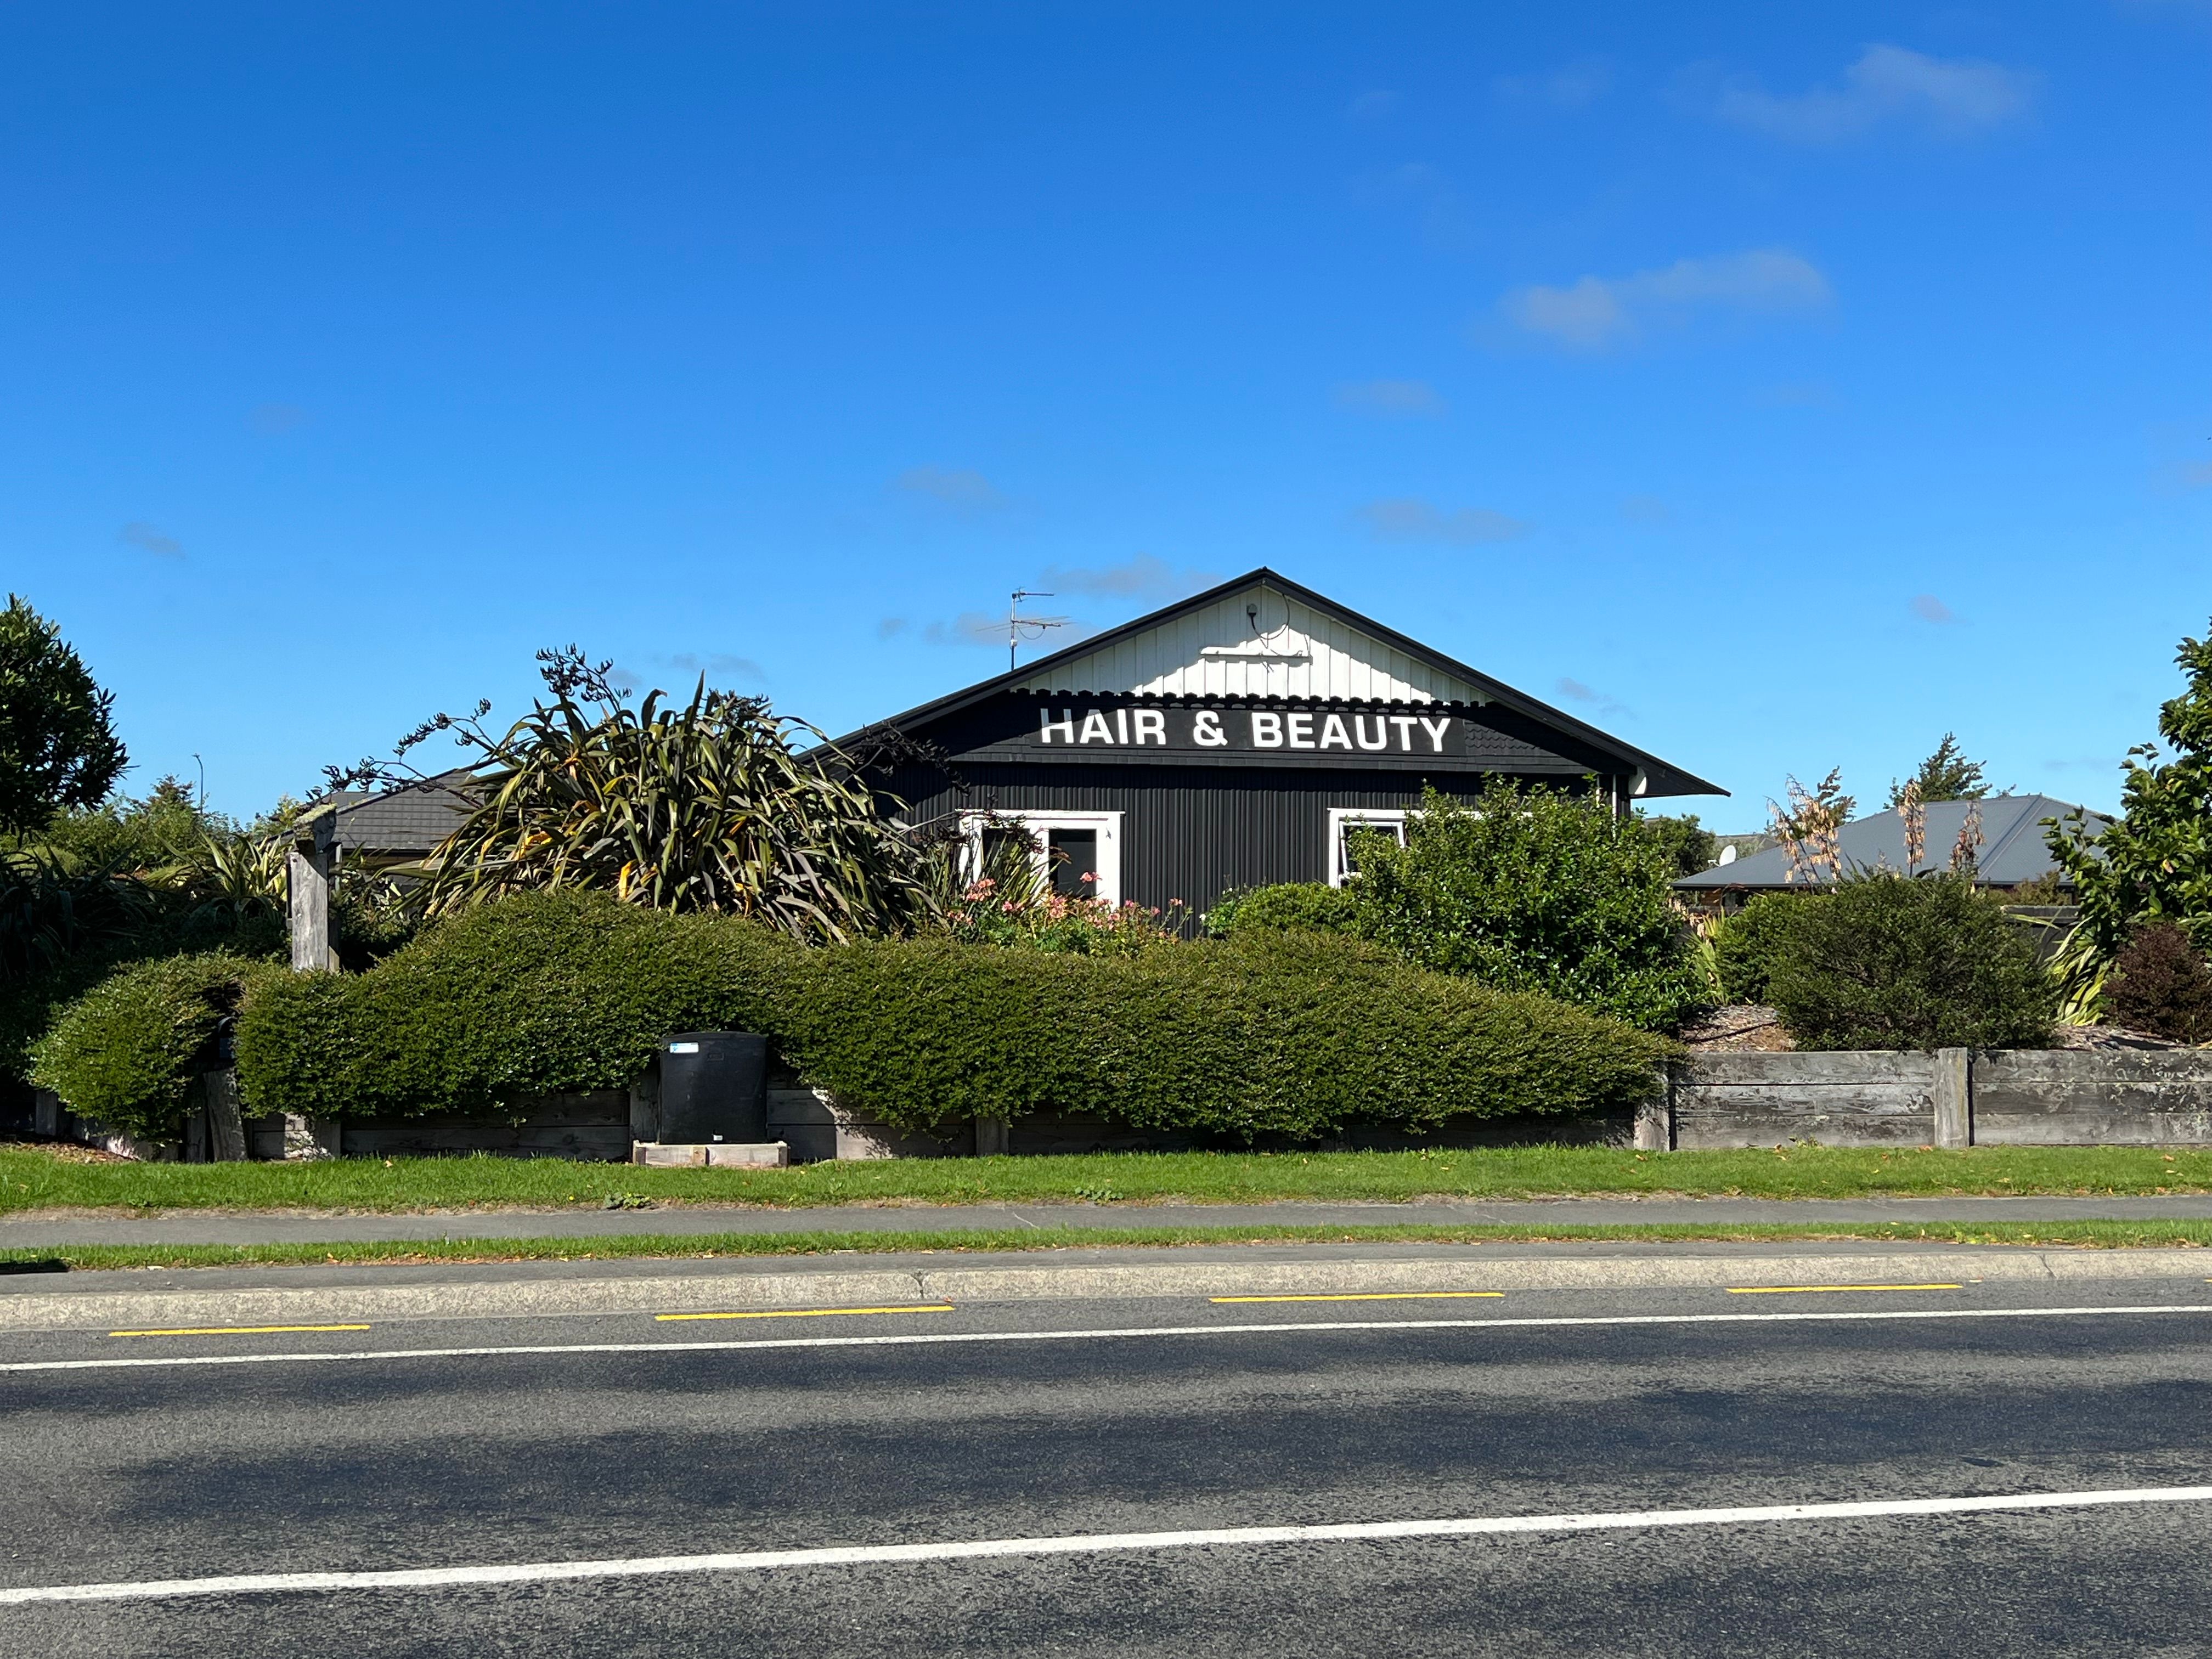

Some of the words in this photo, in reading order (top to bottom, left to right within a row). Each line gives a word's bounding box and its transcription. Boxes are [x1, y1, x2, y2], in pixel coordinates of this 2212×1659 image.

[1040, 707, 1166, 746] HAIR
[1192, 710, 1227, 747] &
[1251, 712, 1451, 752] BEAUTY
